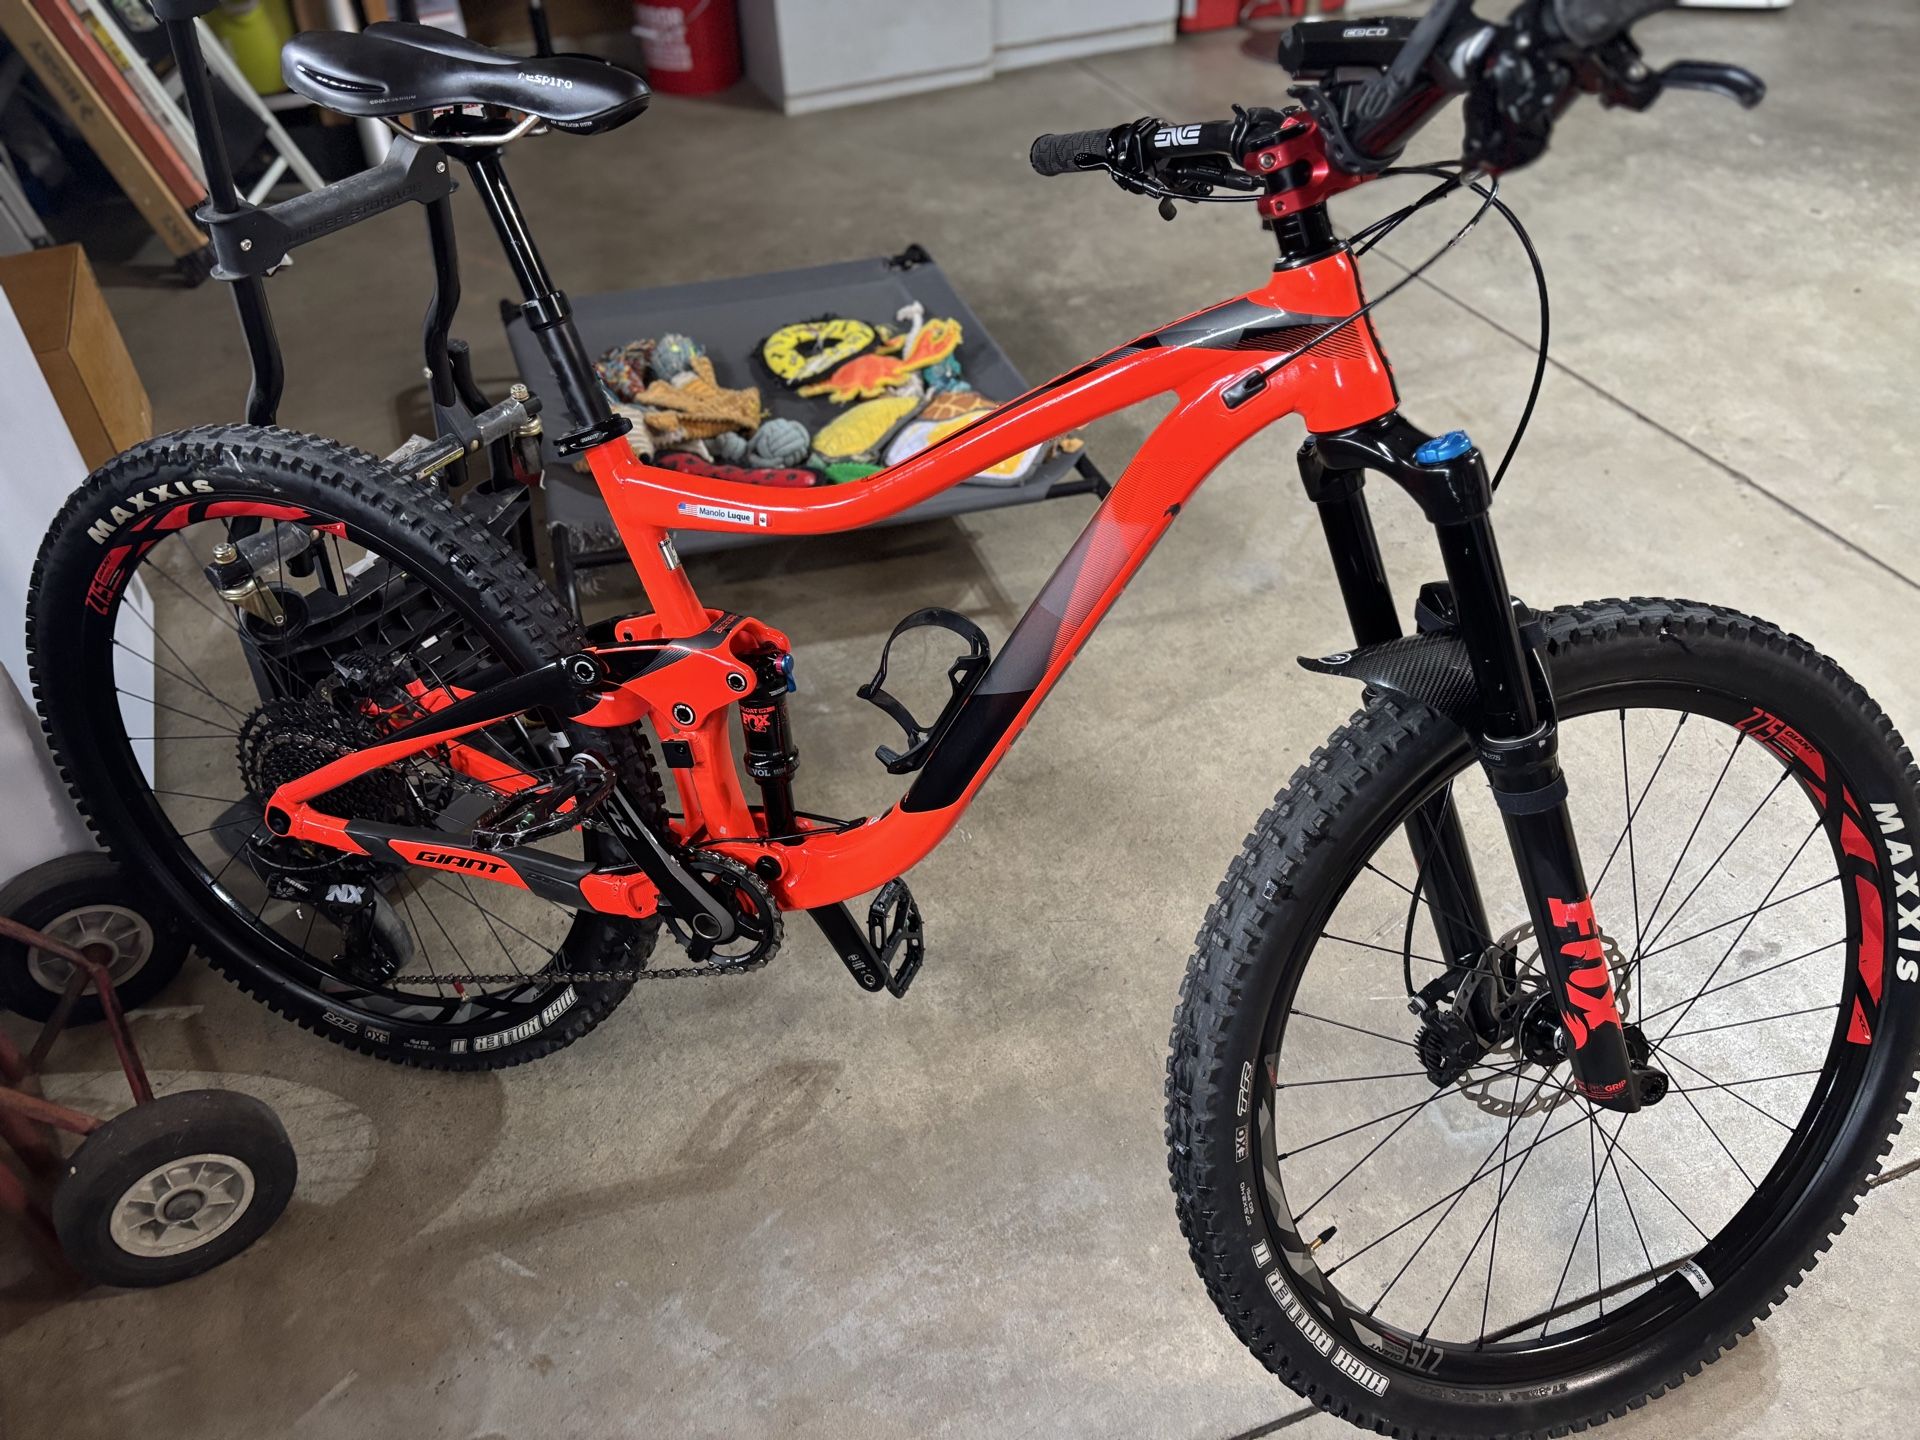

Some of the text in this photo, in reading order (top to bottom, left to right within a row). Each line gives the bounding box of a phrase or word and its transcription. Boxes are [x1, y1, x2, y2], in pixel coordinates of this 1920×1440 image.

[86, 479, 215, 545] MAXXIS
[699, 507, 751, 522] Manolo Luque
[742, 712, 770, 730] FOX
[1785, 731, 1817, 754] GIANT
[751, 768, 771, 777] VOL
[415, 851, 508, 875] GIANT
[325, 884, 366, 905] NX
[1869, 803, 1920, 983] MAXXIS
[541, 984, 579, 1027] HIGH
[365, 1025, 391, 1045] EXO
[473, 1016, 543, 1053] ROLLER
[1237, 1060, 1252, 1116] TR
[1604, 1079, 1627, 1092] GRIP
[1236, 1127, 1248, 1162] EXO
[1265, 1268, 1335, 1357] ROLLER
[1370, 1343, 1404, 1362] GIANT
[1331, 1346, 1390, 1397] HIGH
